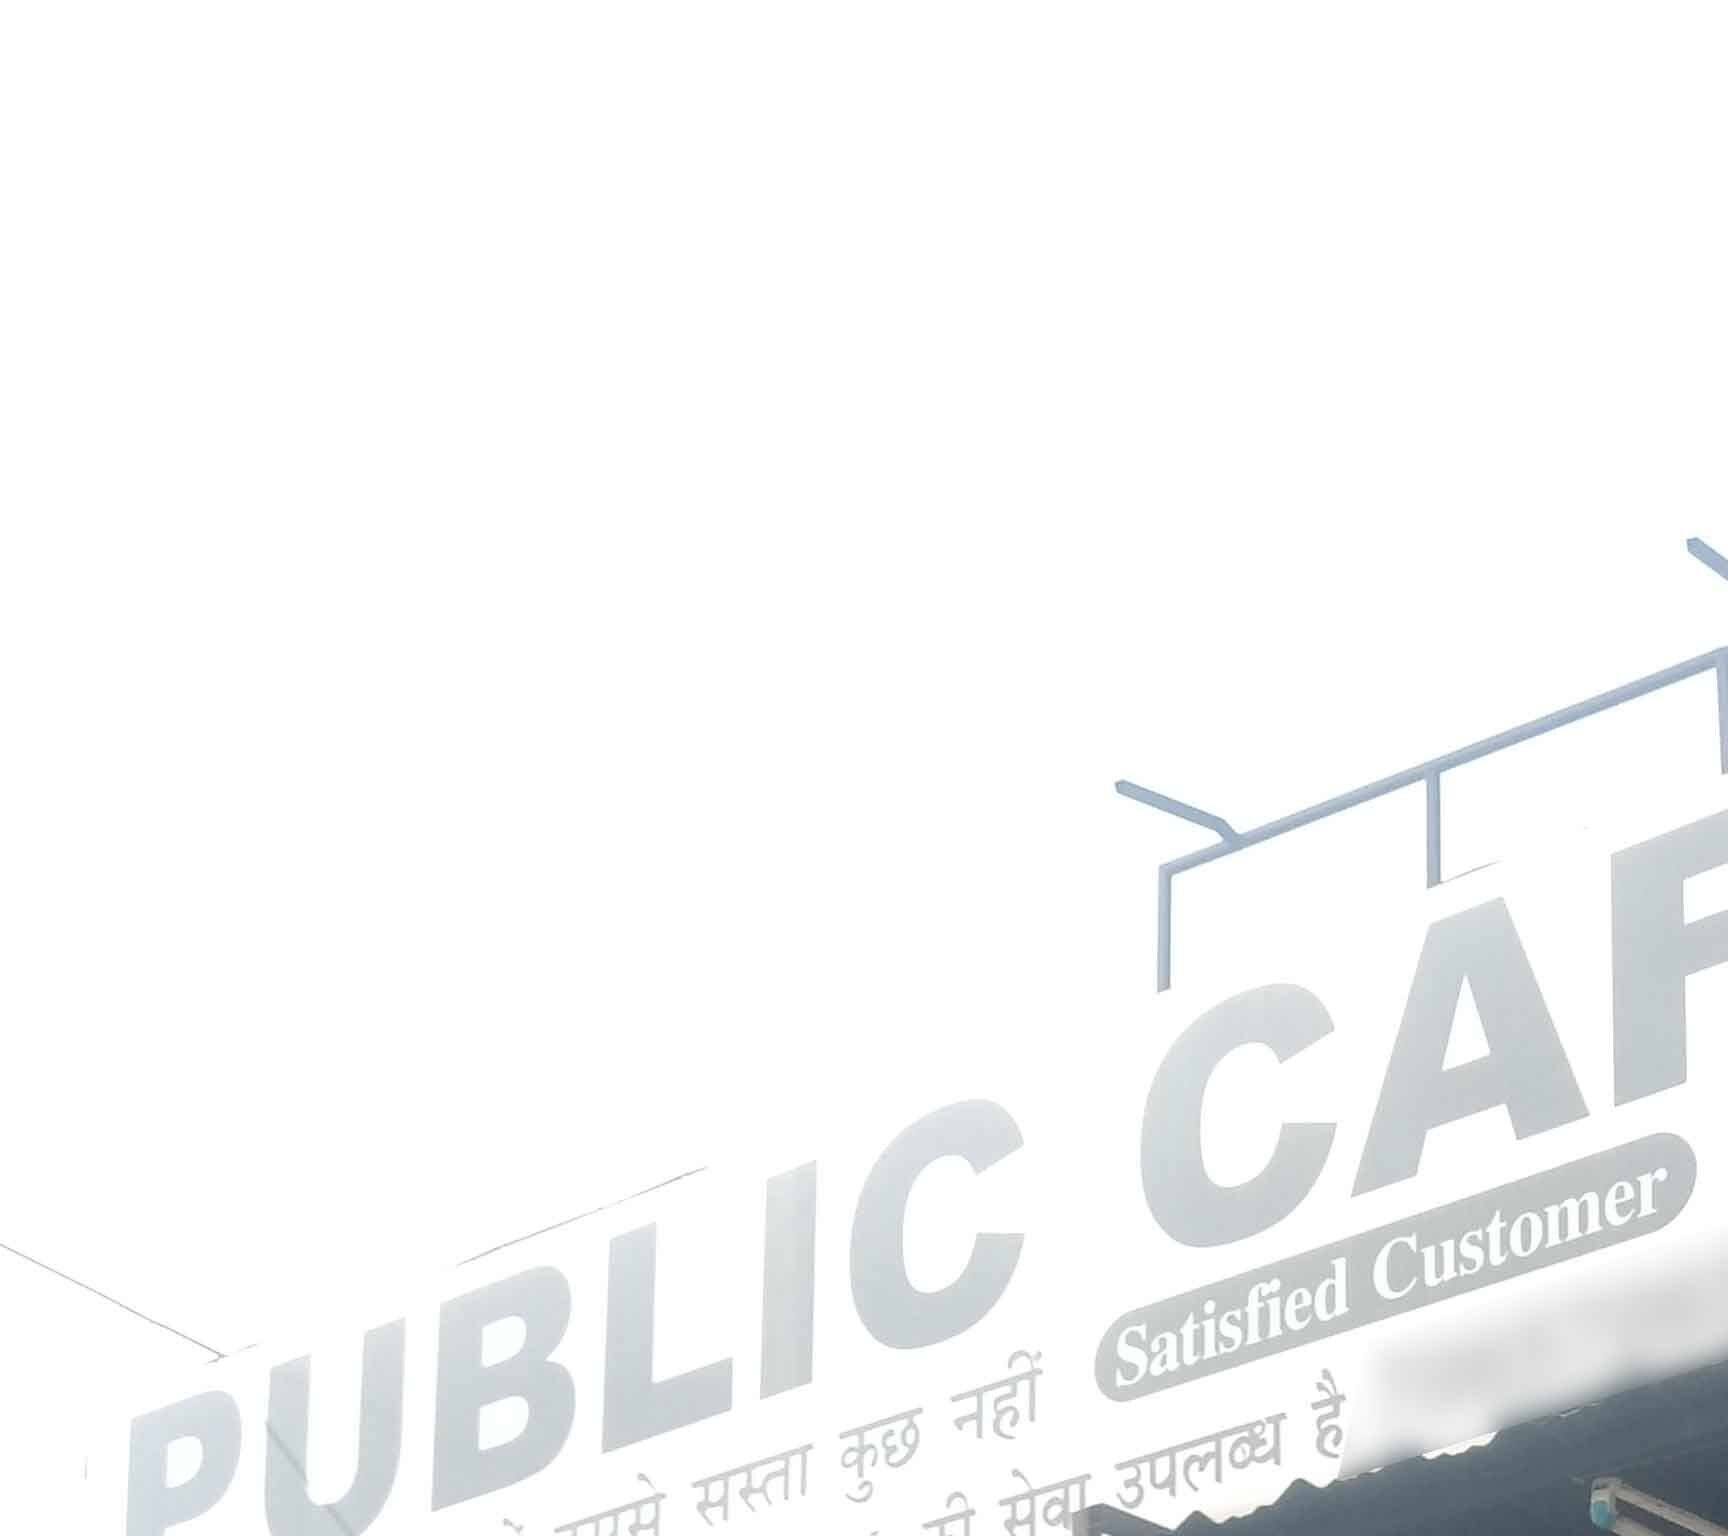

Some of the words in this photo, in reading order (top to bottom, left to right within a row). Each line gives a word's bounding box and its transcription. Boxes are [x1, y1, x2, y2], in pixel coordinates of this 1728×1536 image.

[1113, 1257, 1350, 1389] Satisfied
[1372, 1160, 1671, 1303] Customer
[691, 1443, 814, 1527] सस्ता
[839, 1406, 924, 1503] कुछ
[951, 1349, 1043, 1440] नहीं
[1115, 1413, 1289, 1509] उपलब्ध
[1310, 1368, 1347, 1460] है
